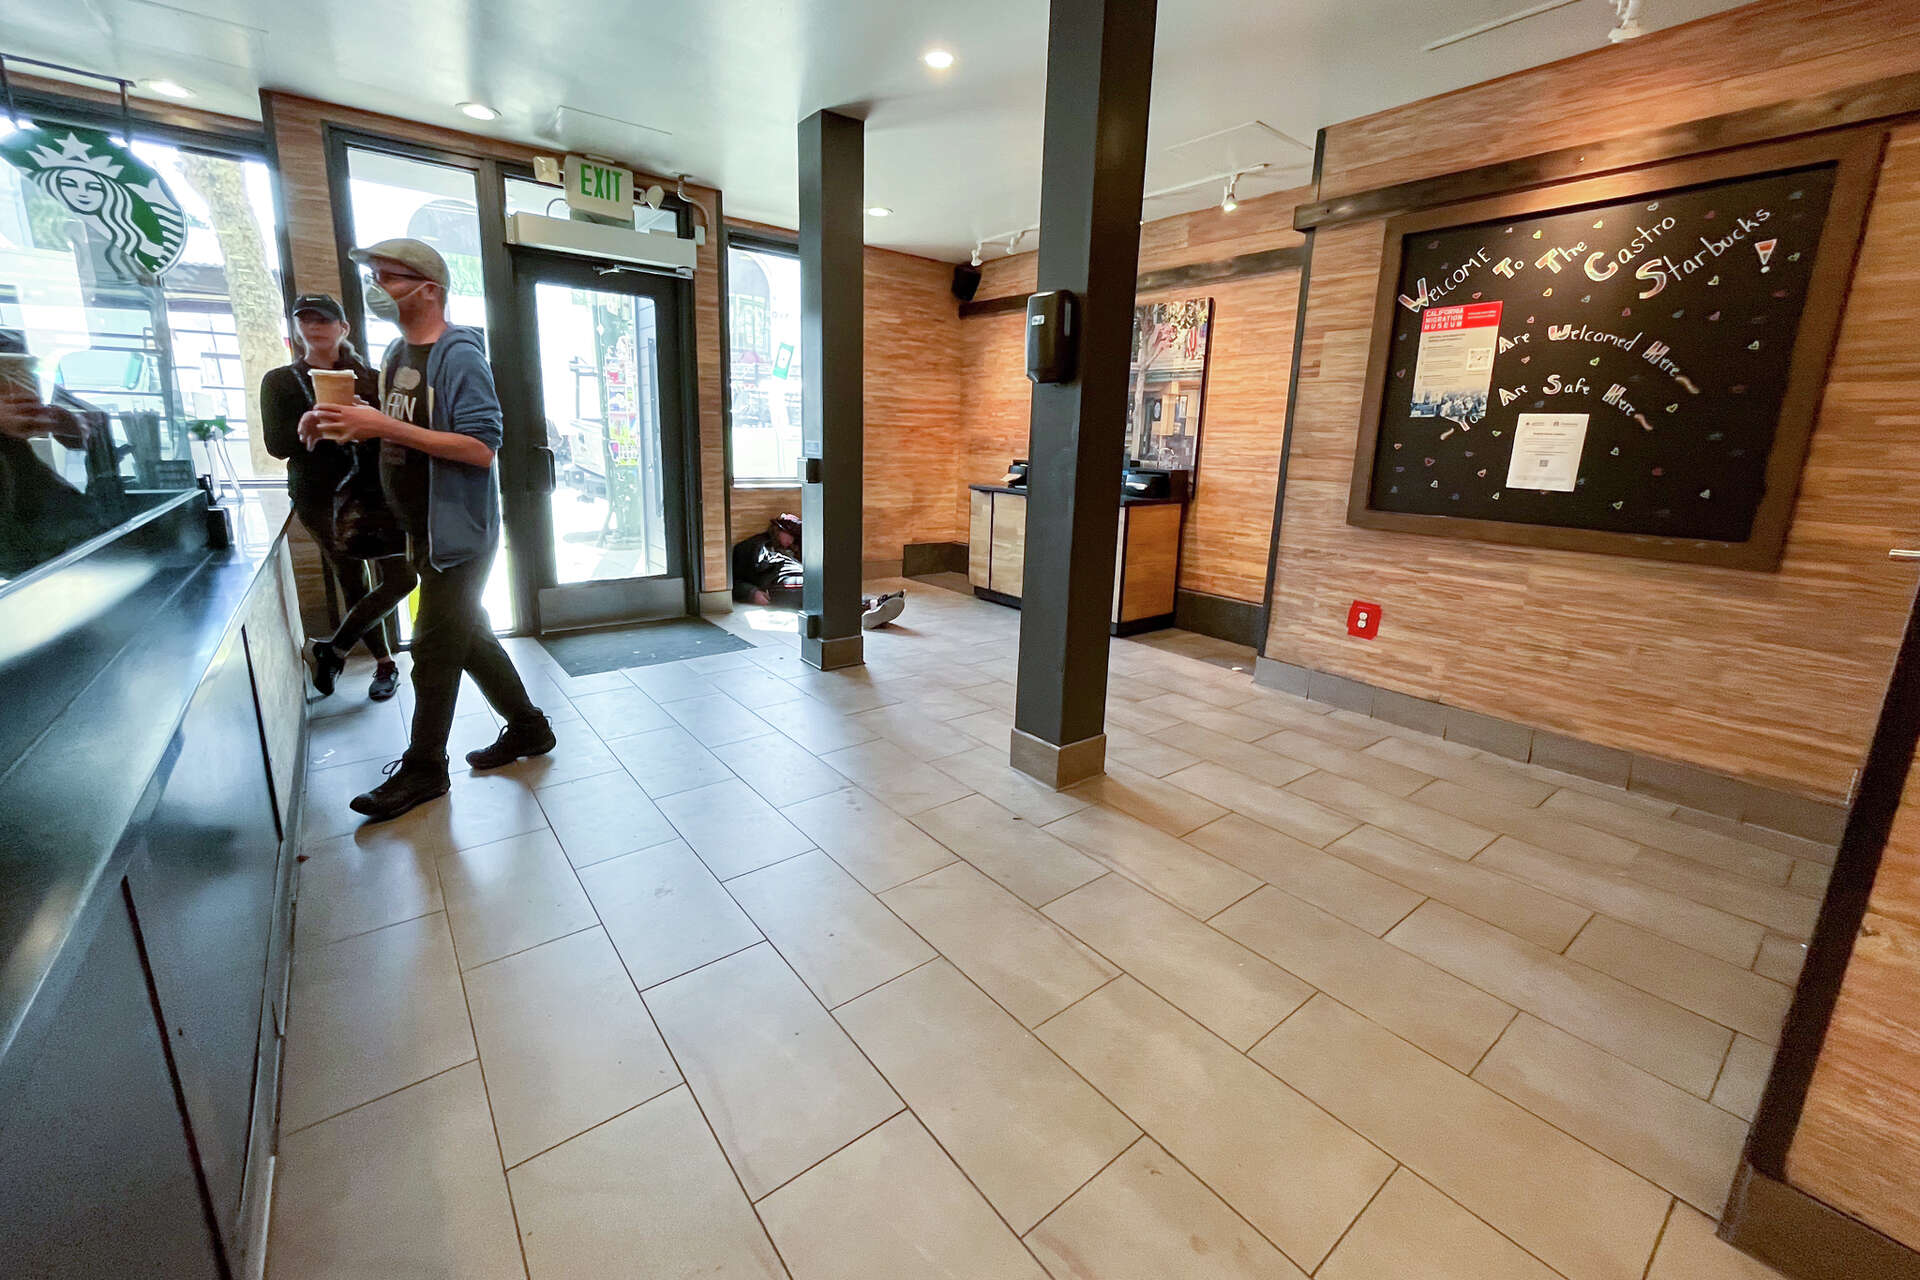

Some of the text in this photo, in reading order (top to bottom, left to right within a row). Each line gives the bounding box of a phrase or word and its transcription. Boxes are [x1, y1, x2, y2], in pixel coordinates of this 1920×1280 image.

[580, 163, 623, 203] EXIT
[1492, 257, 1525, 279] To
[1534, 241, 1588, 274] The
[1583, 216, 1676, 282] Castro
[1635, 209, 1771, 299] Starbucks
[1424, 321, 1462, 330] MUSEUM
[1425, 314, 1463, 324] MIGRATION
[1498, 324, 1682, 377] Are Welcomed Here
[1498, 385, 1529, 407] Are
[1542, 374, 1591, 395] Safe
[1601, 383, 1636, 416] Here
